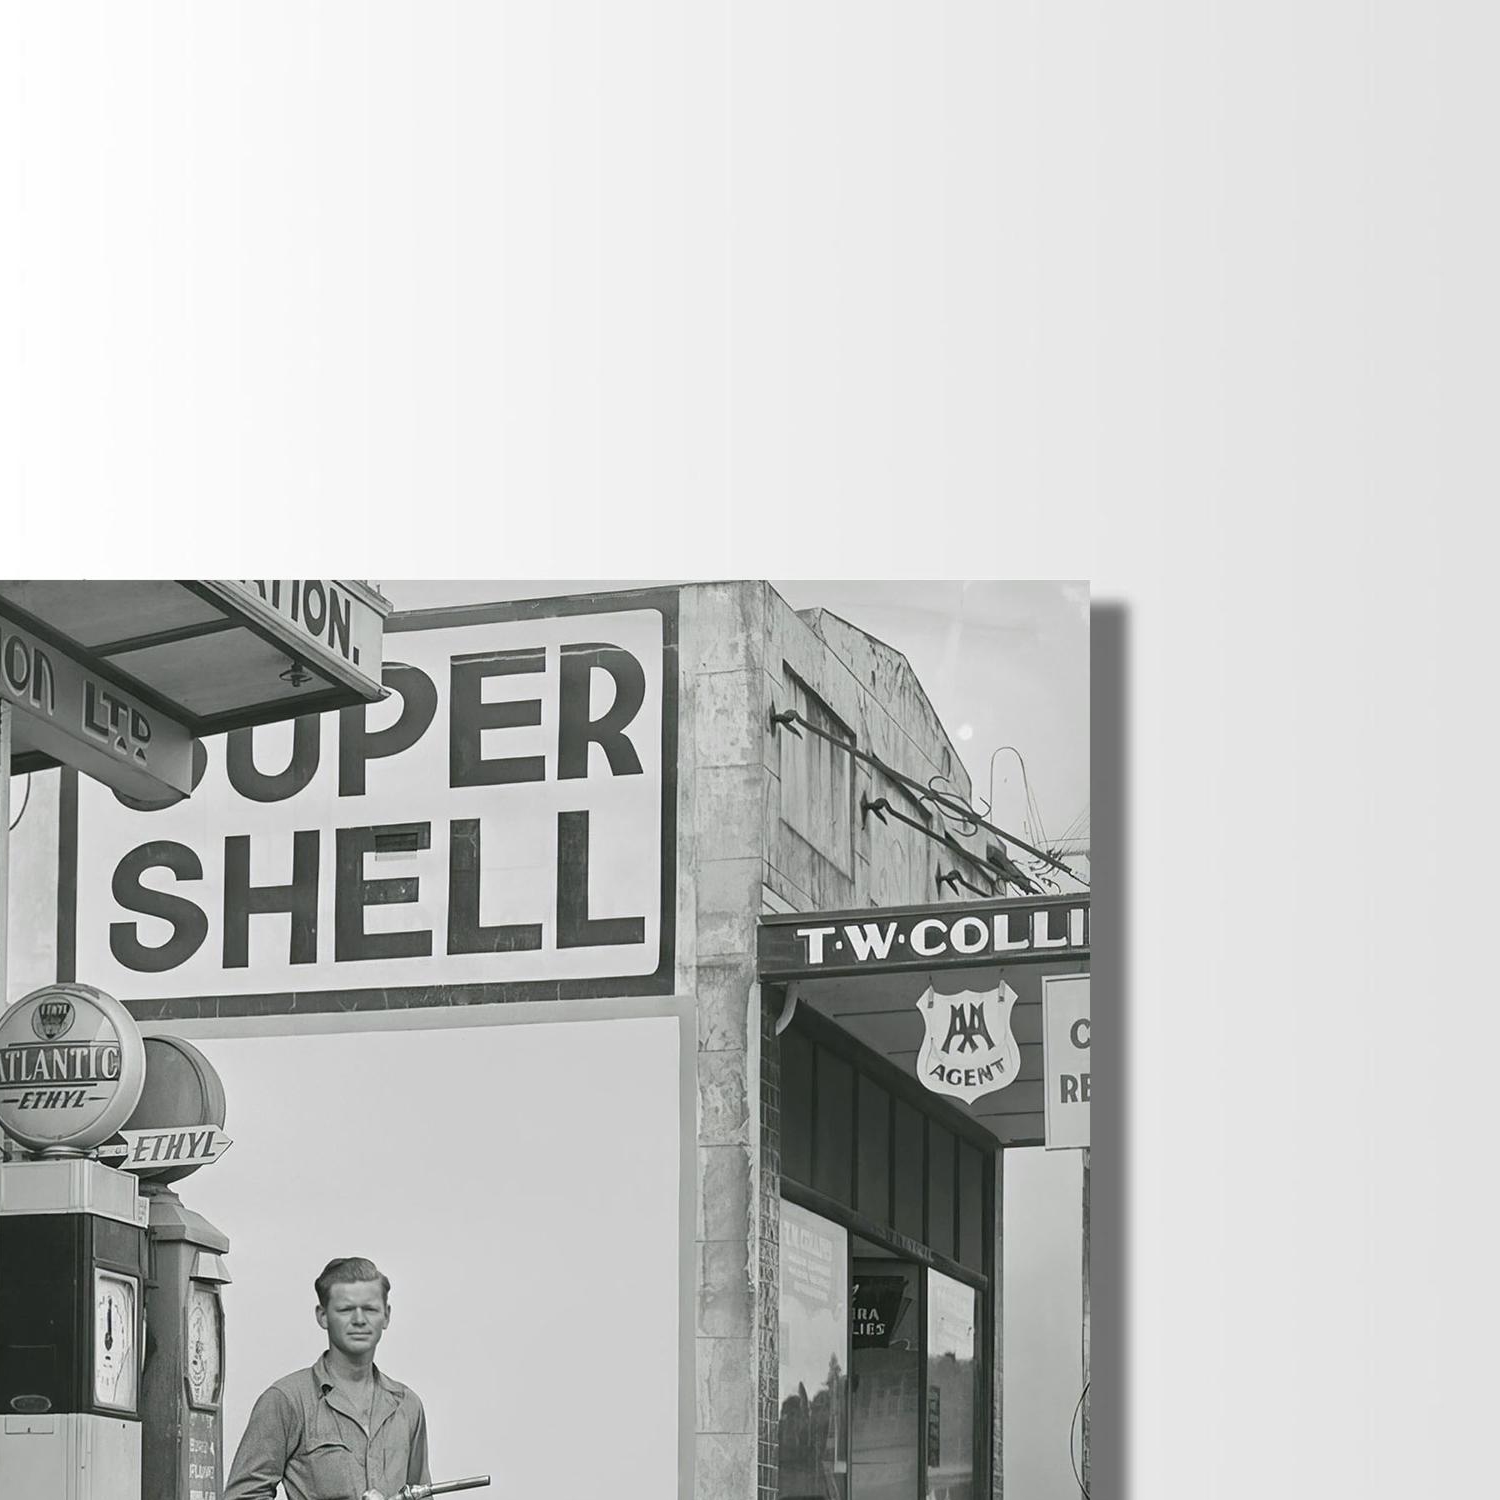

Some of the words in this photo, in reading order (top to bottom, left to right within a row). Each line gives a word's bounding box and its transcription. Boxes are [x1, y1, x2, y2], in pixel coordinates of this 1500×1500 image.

[110, 810, 646, 973] SHELL
[929, 1057, 1005, 1087] AGENT
[18, 1089, 86, 1110] ETHYL
[132, 1129, 217, 1162] ETHYL
